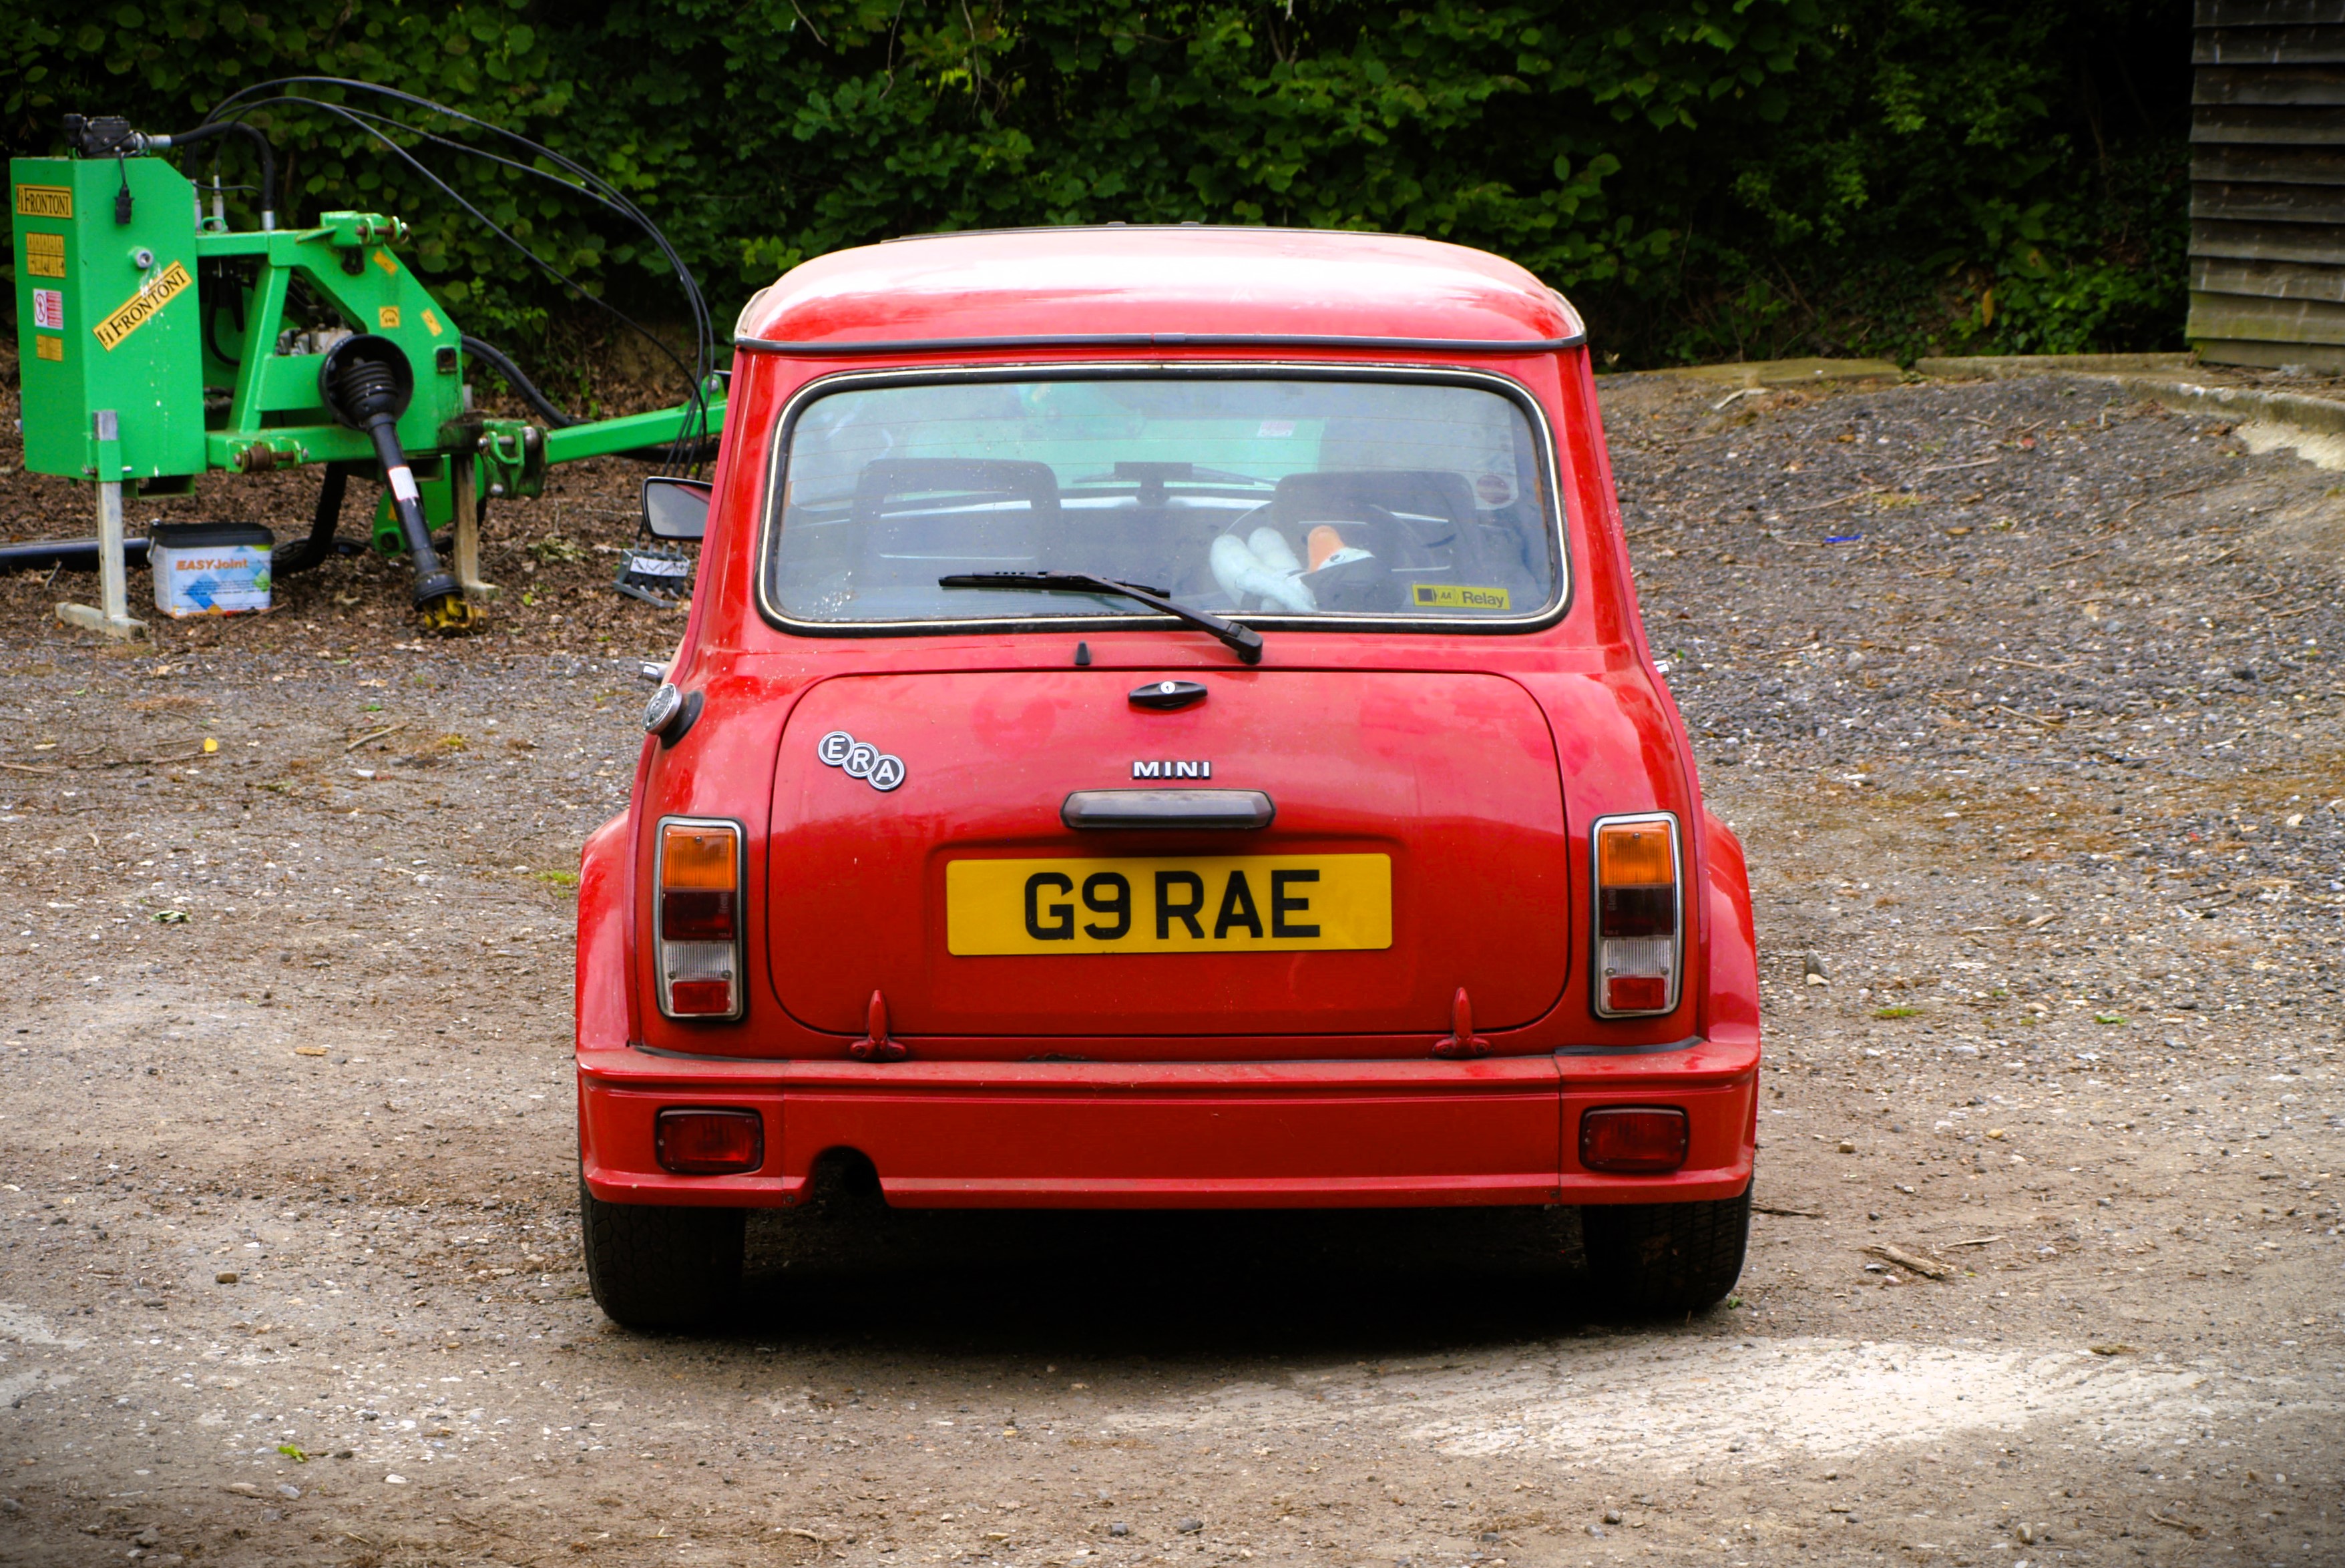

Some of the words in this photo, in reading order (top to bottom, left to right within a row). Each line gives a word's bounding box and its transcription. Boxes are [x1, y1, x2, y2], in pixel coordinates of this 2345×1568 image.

[1462, 591, 1504, 608] Relay
[827, 736, 896, 782] ERA
[1133, 760, 1211, 780] MINI
[1024, 871, 1132, 941] G9
[1154, 868, 1321, 940] RAE
